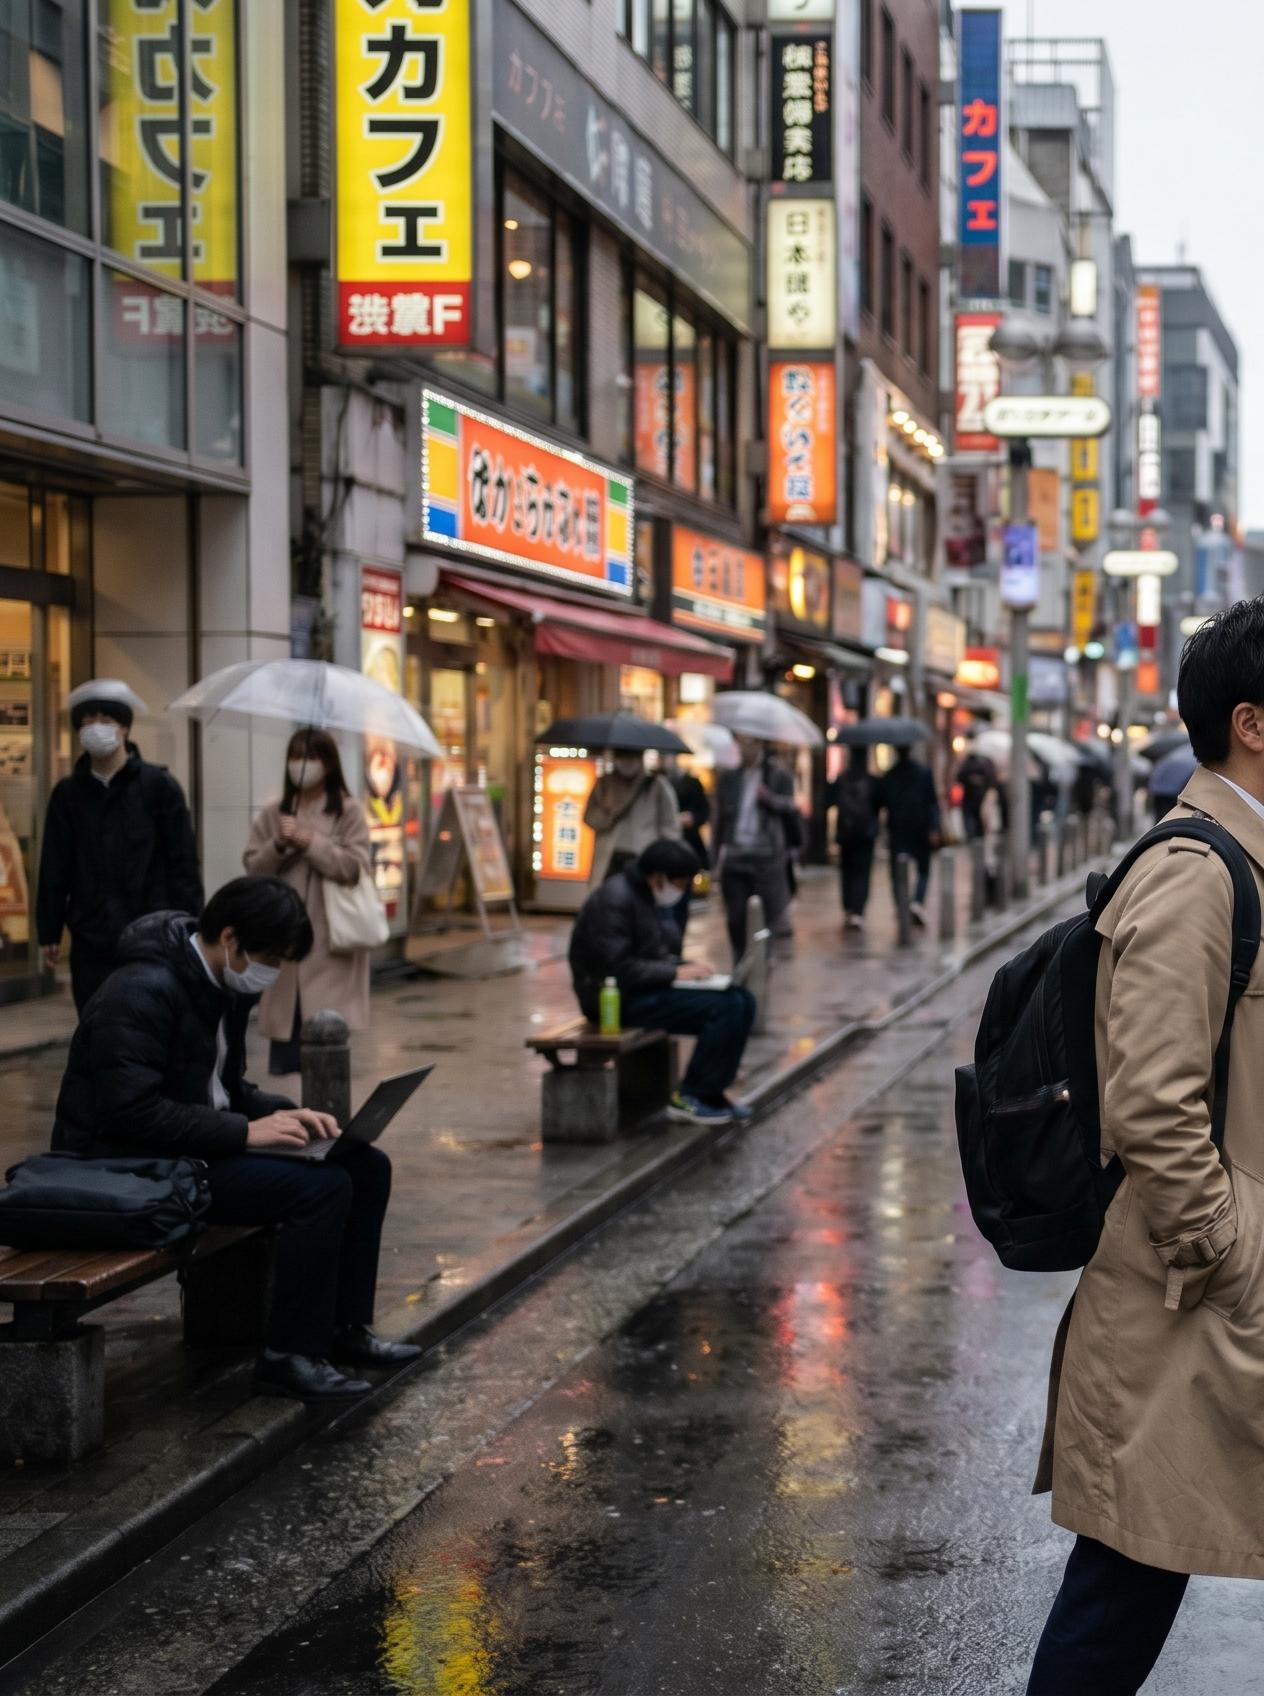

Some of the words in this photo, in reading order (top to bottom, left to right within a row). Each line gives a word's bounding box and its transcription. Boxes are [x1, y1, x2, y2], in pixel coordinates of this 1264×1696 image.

[360, 0, 446, 262] カフェ
[962, 99, 998, 230] カフェ
